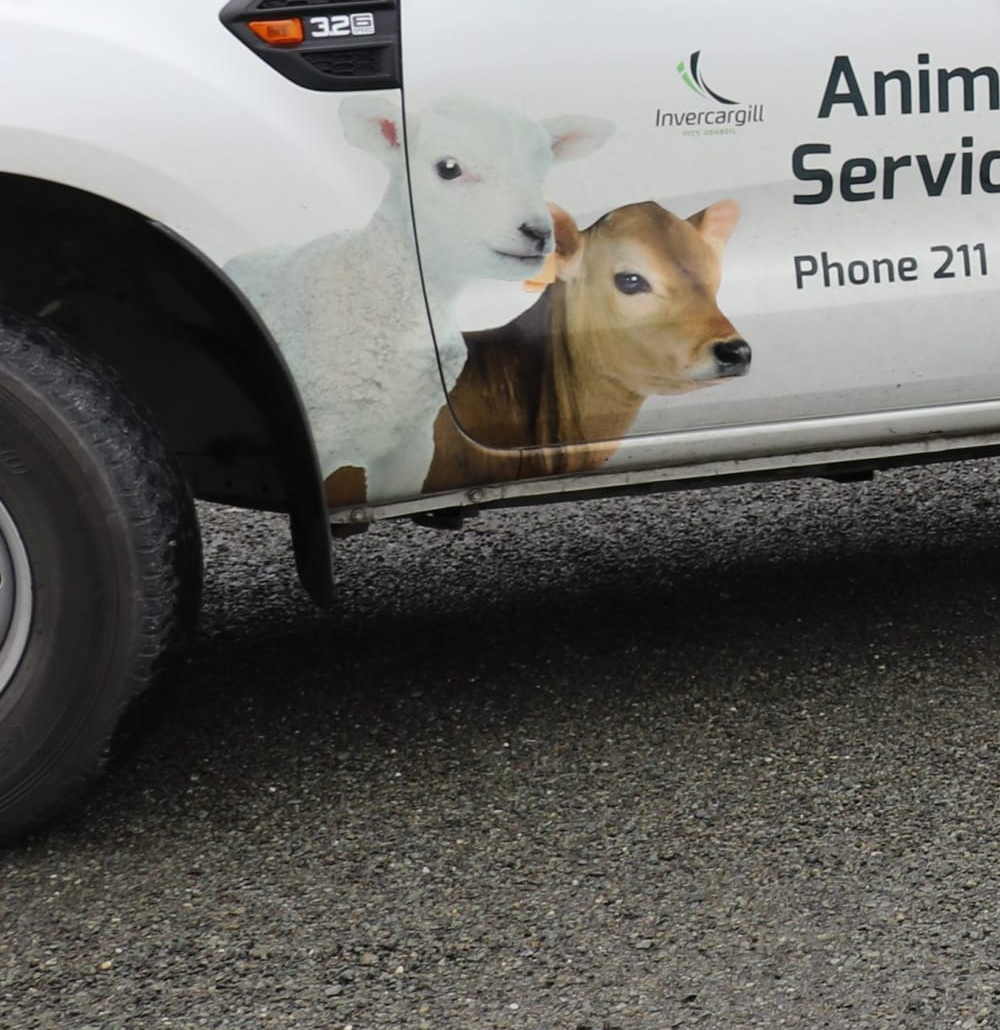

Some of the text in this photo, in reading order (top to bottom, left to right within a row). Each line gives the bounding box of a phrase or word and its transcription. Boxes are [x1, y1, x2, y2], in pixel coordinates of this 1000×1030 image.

[655, 104, 764, 127] Invercargill
[794, 251, 918, 289] Phone
[930, 242, 988, 279] 211
